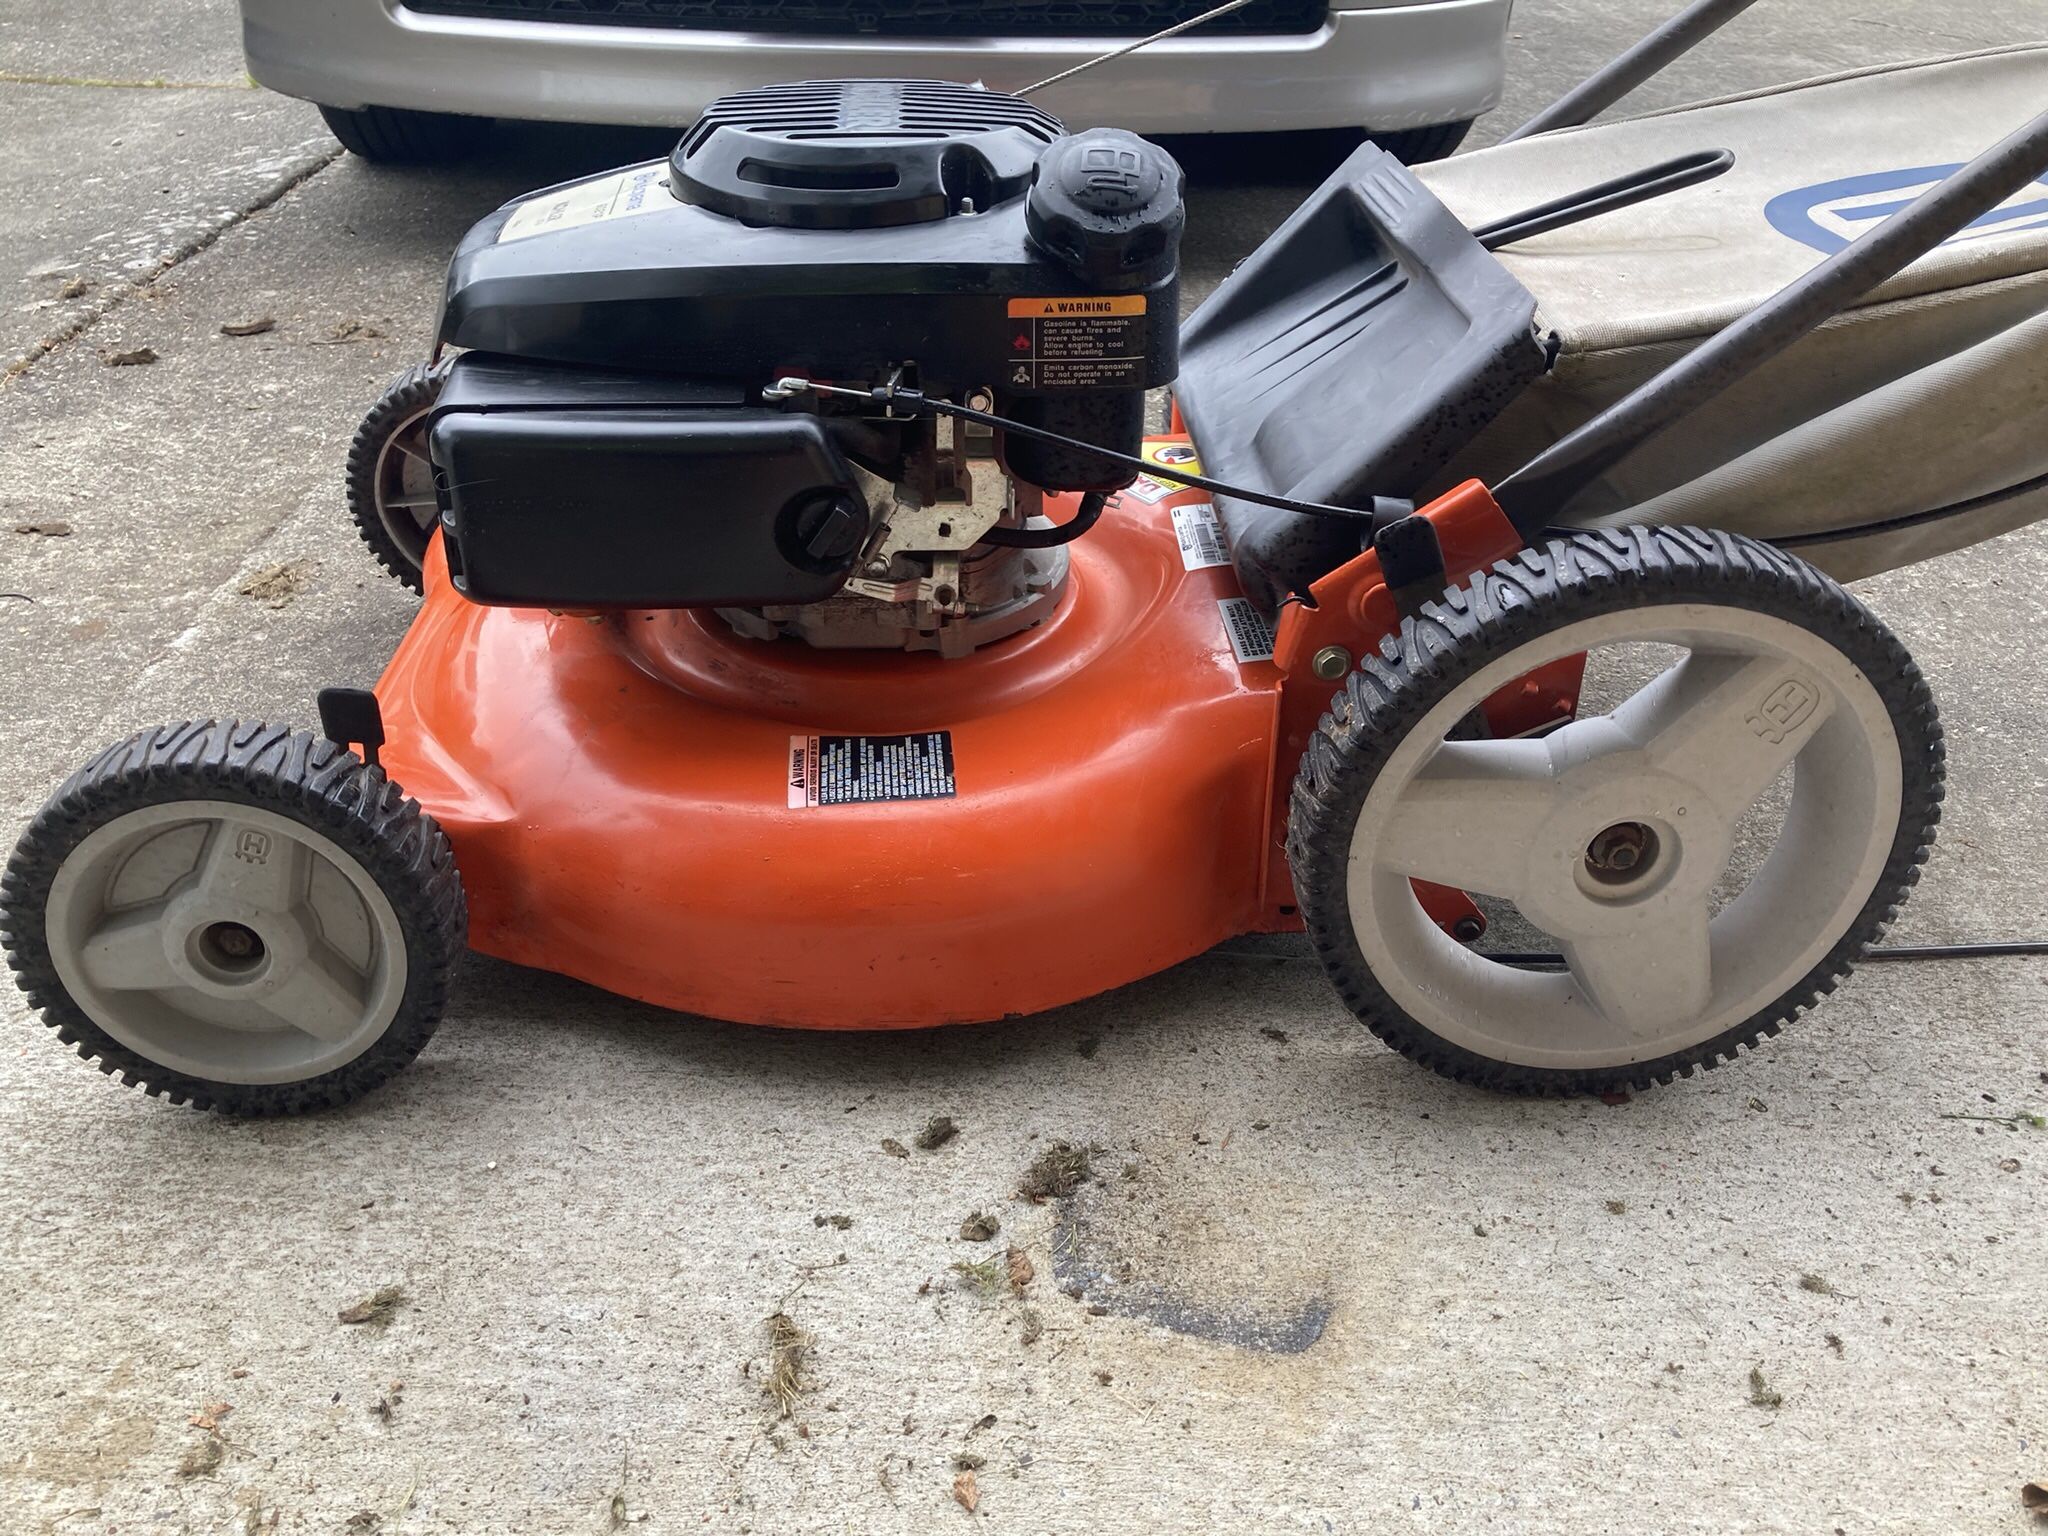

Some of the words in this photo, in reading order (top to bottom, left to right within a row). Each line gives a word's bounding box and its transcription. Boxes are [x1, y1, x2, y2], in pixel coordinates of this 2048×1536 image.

[1058, 303, 1111, 312] WARNING
[1068, 343, 1093, 351] engine
[792, 748, 804, 778] WARNING
